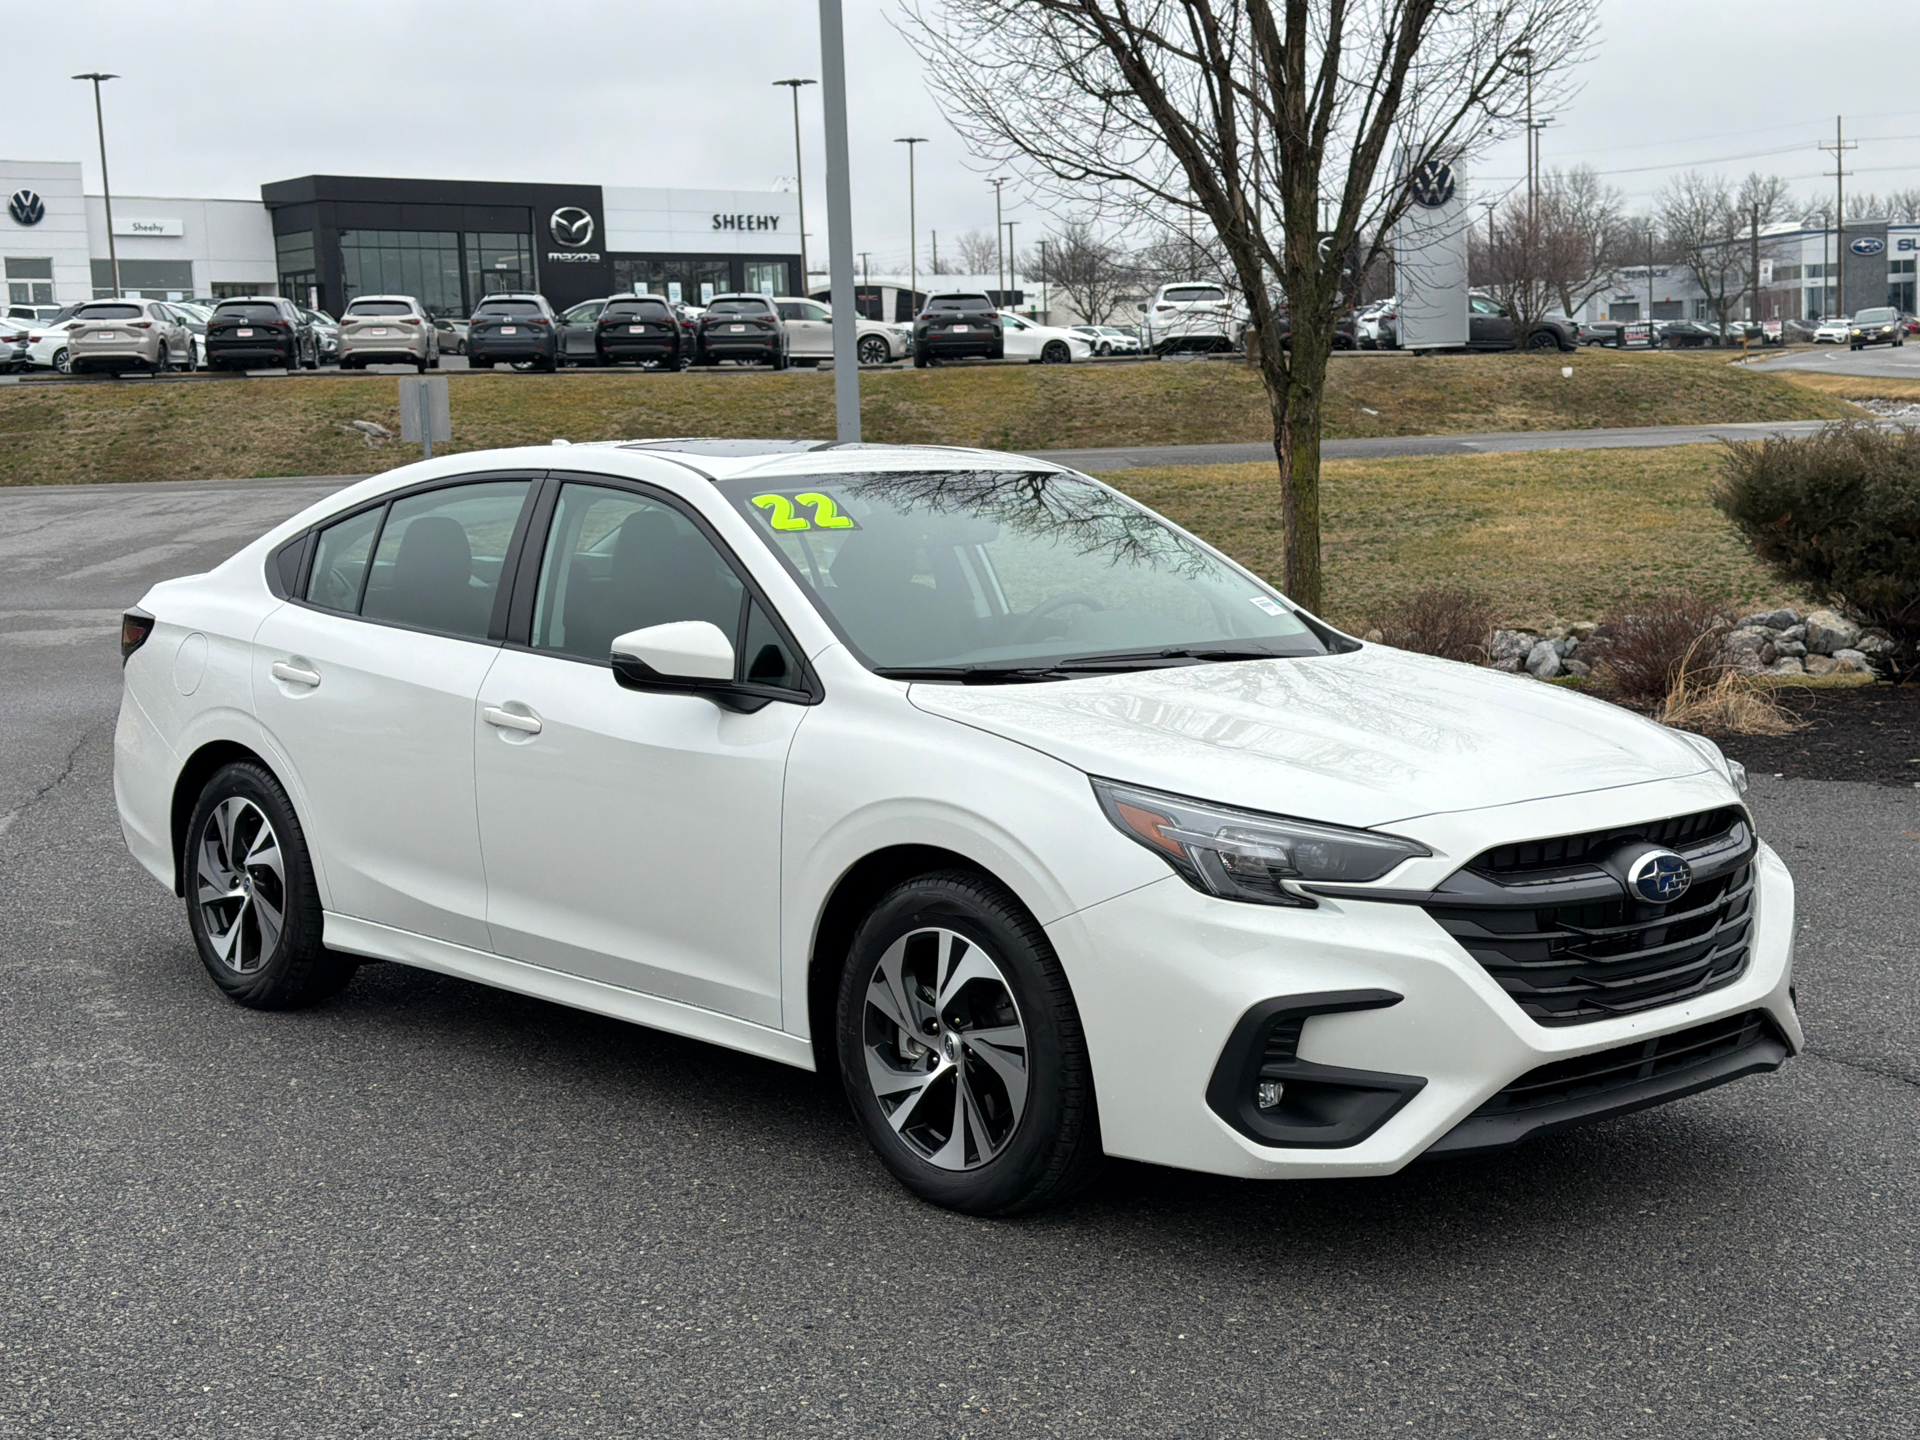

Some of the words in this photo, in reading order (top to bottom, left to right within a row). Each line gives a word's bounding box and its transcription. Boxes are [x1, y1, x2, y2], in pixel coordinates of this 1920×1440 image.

[132, 222, 164, 233] Sheehy
[712, 213, 780, 231] SHEEHY
[751, 492, 855, 531] 22
